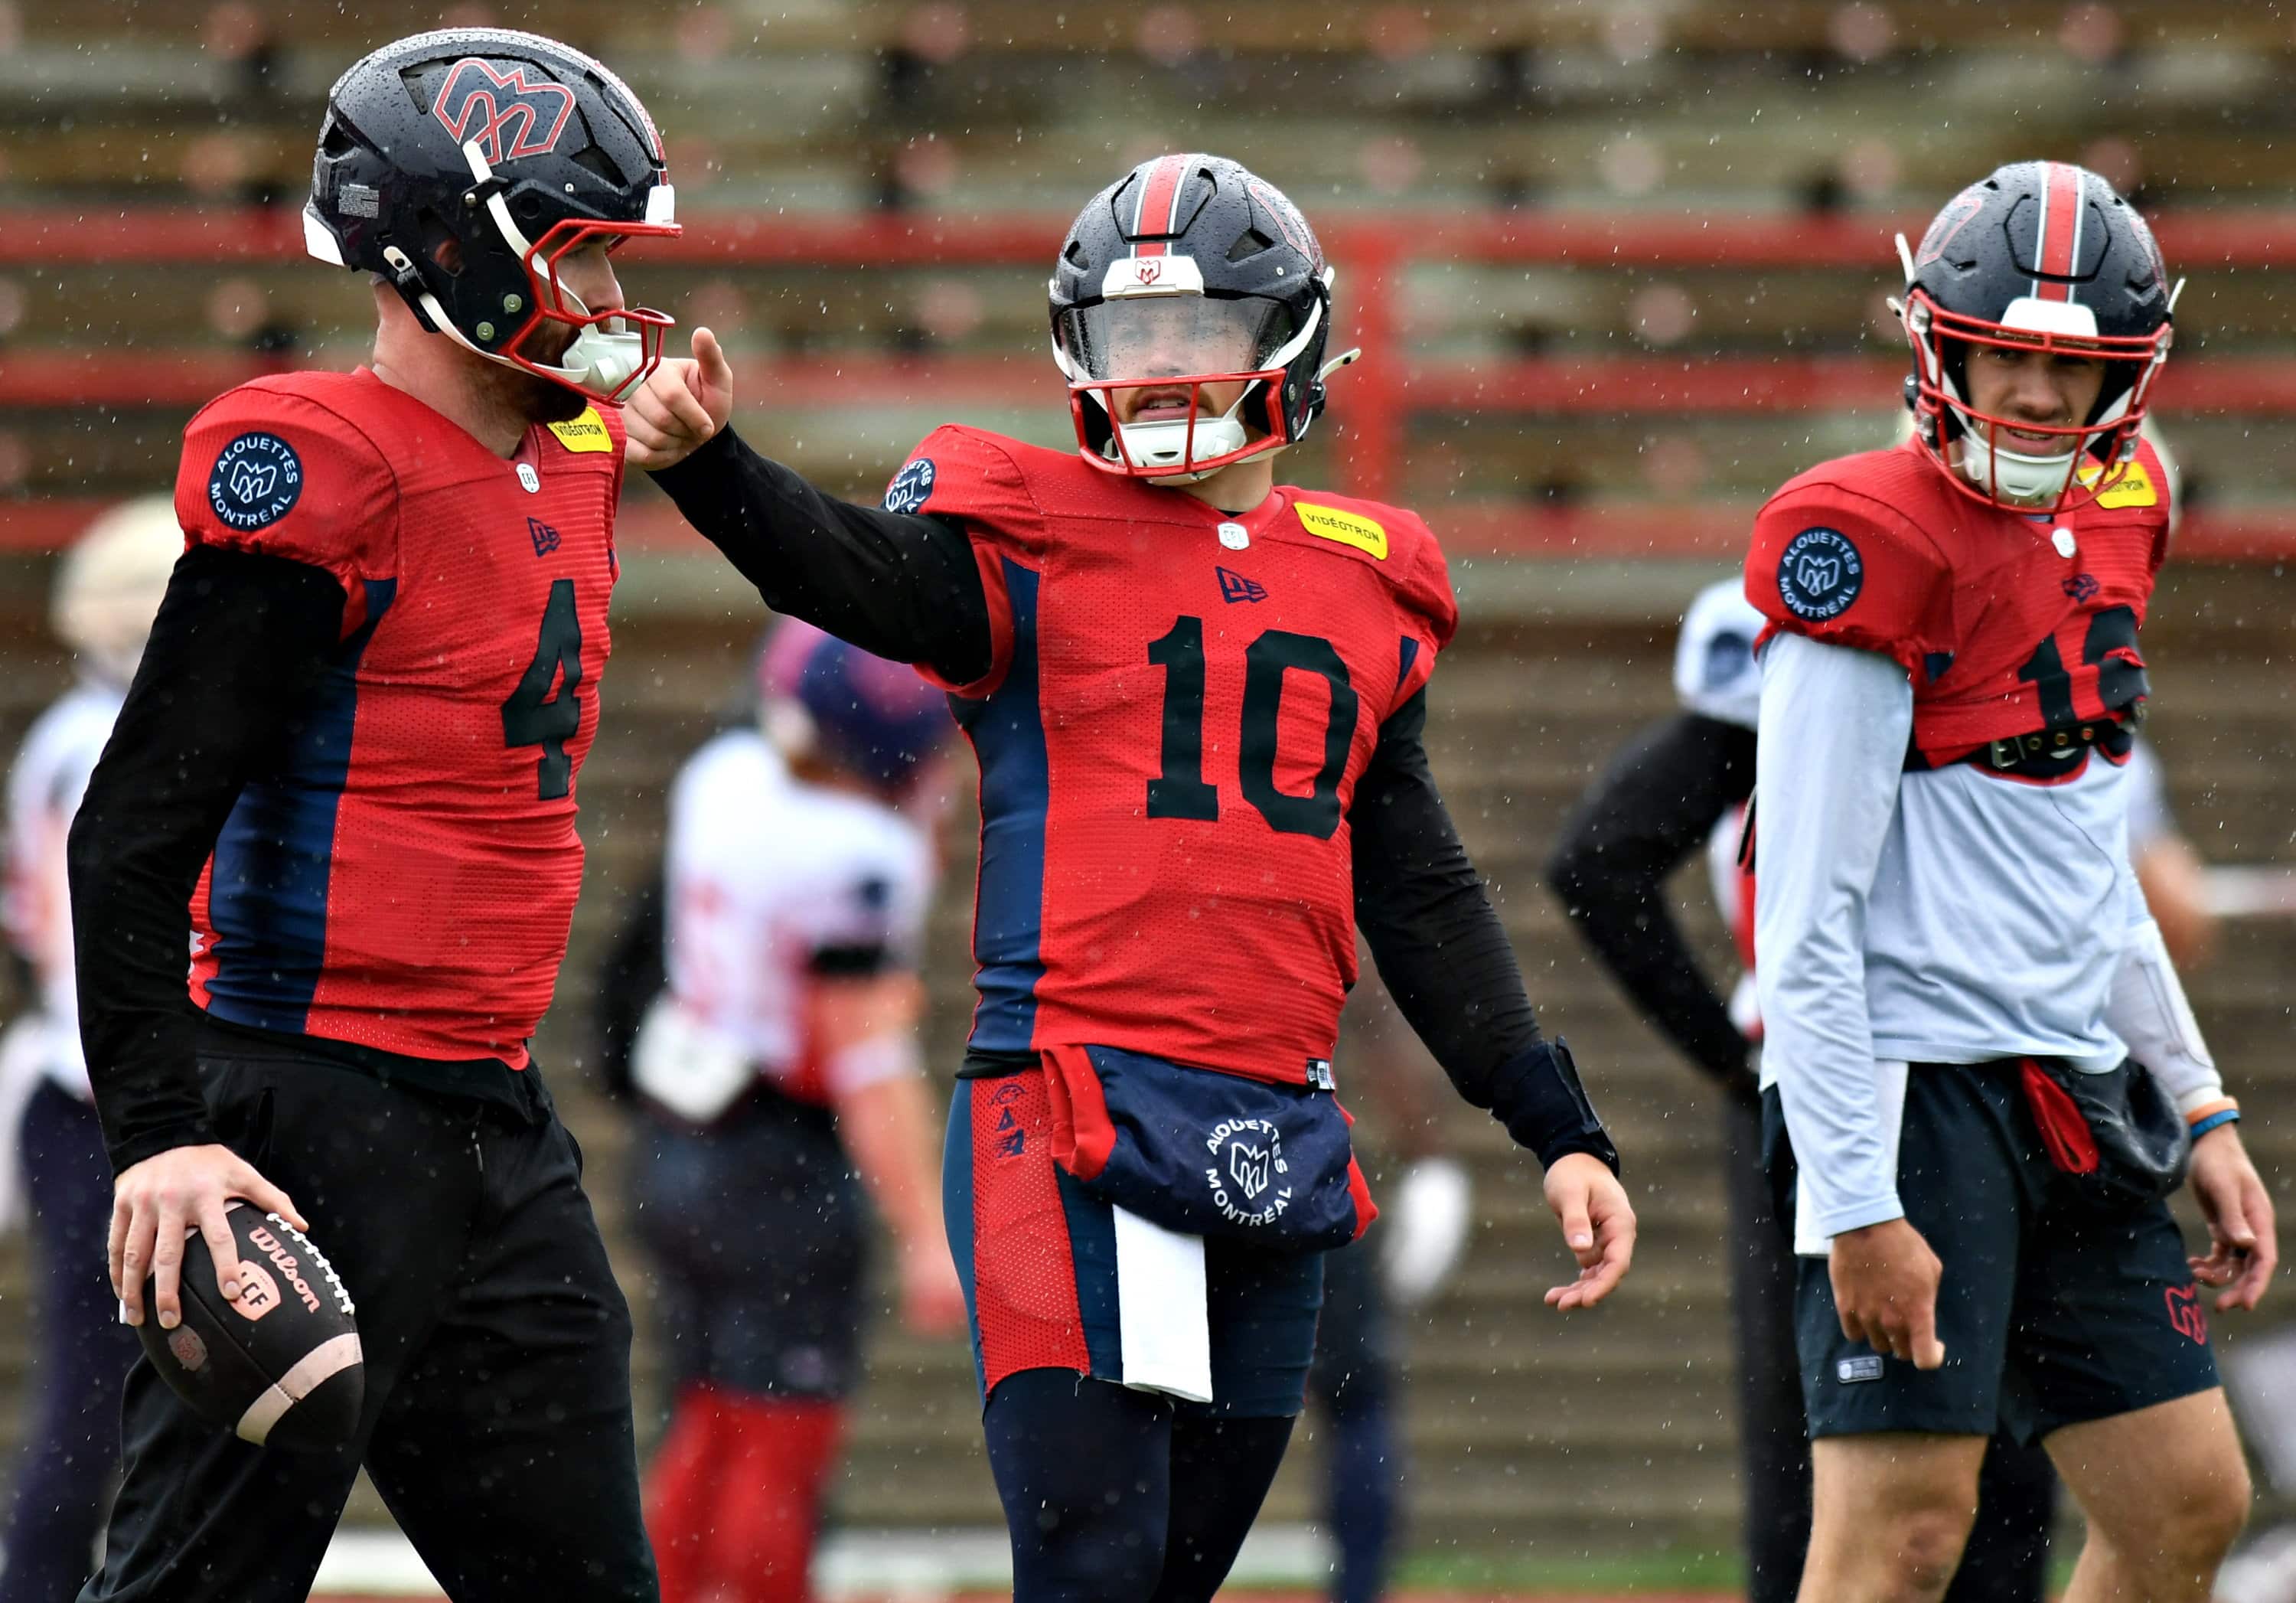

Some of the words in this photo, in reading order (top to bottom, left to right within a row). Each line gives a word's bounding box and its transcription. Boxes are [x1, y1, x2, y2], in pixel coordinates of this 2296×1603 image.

[555, 421, 603, 436] VIDÉOTRON
[217, 436, 298, 484] ALOUETTES
[521, 472, 536, 485] CFL
[211, 482, 292, 526] MONTRÉAL
[1306, 514, 1380, 544] VIDÉOTRON
[1782, 532, 1860, 575] ALOUETTES
[501, 579, 582, 801] 4
[1146, 615, 1358, 840] 10
[1206, 1118, 1288, 1174] ALOUETTES
[1205, 1168, 1292, 1226] MONTRÉAL
[241, 1272, 269, 1306] CF
[249, 1226, 320, 1314] Wilson
